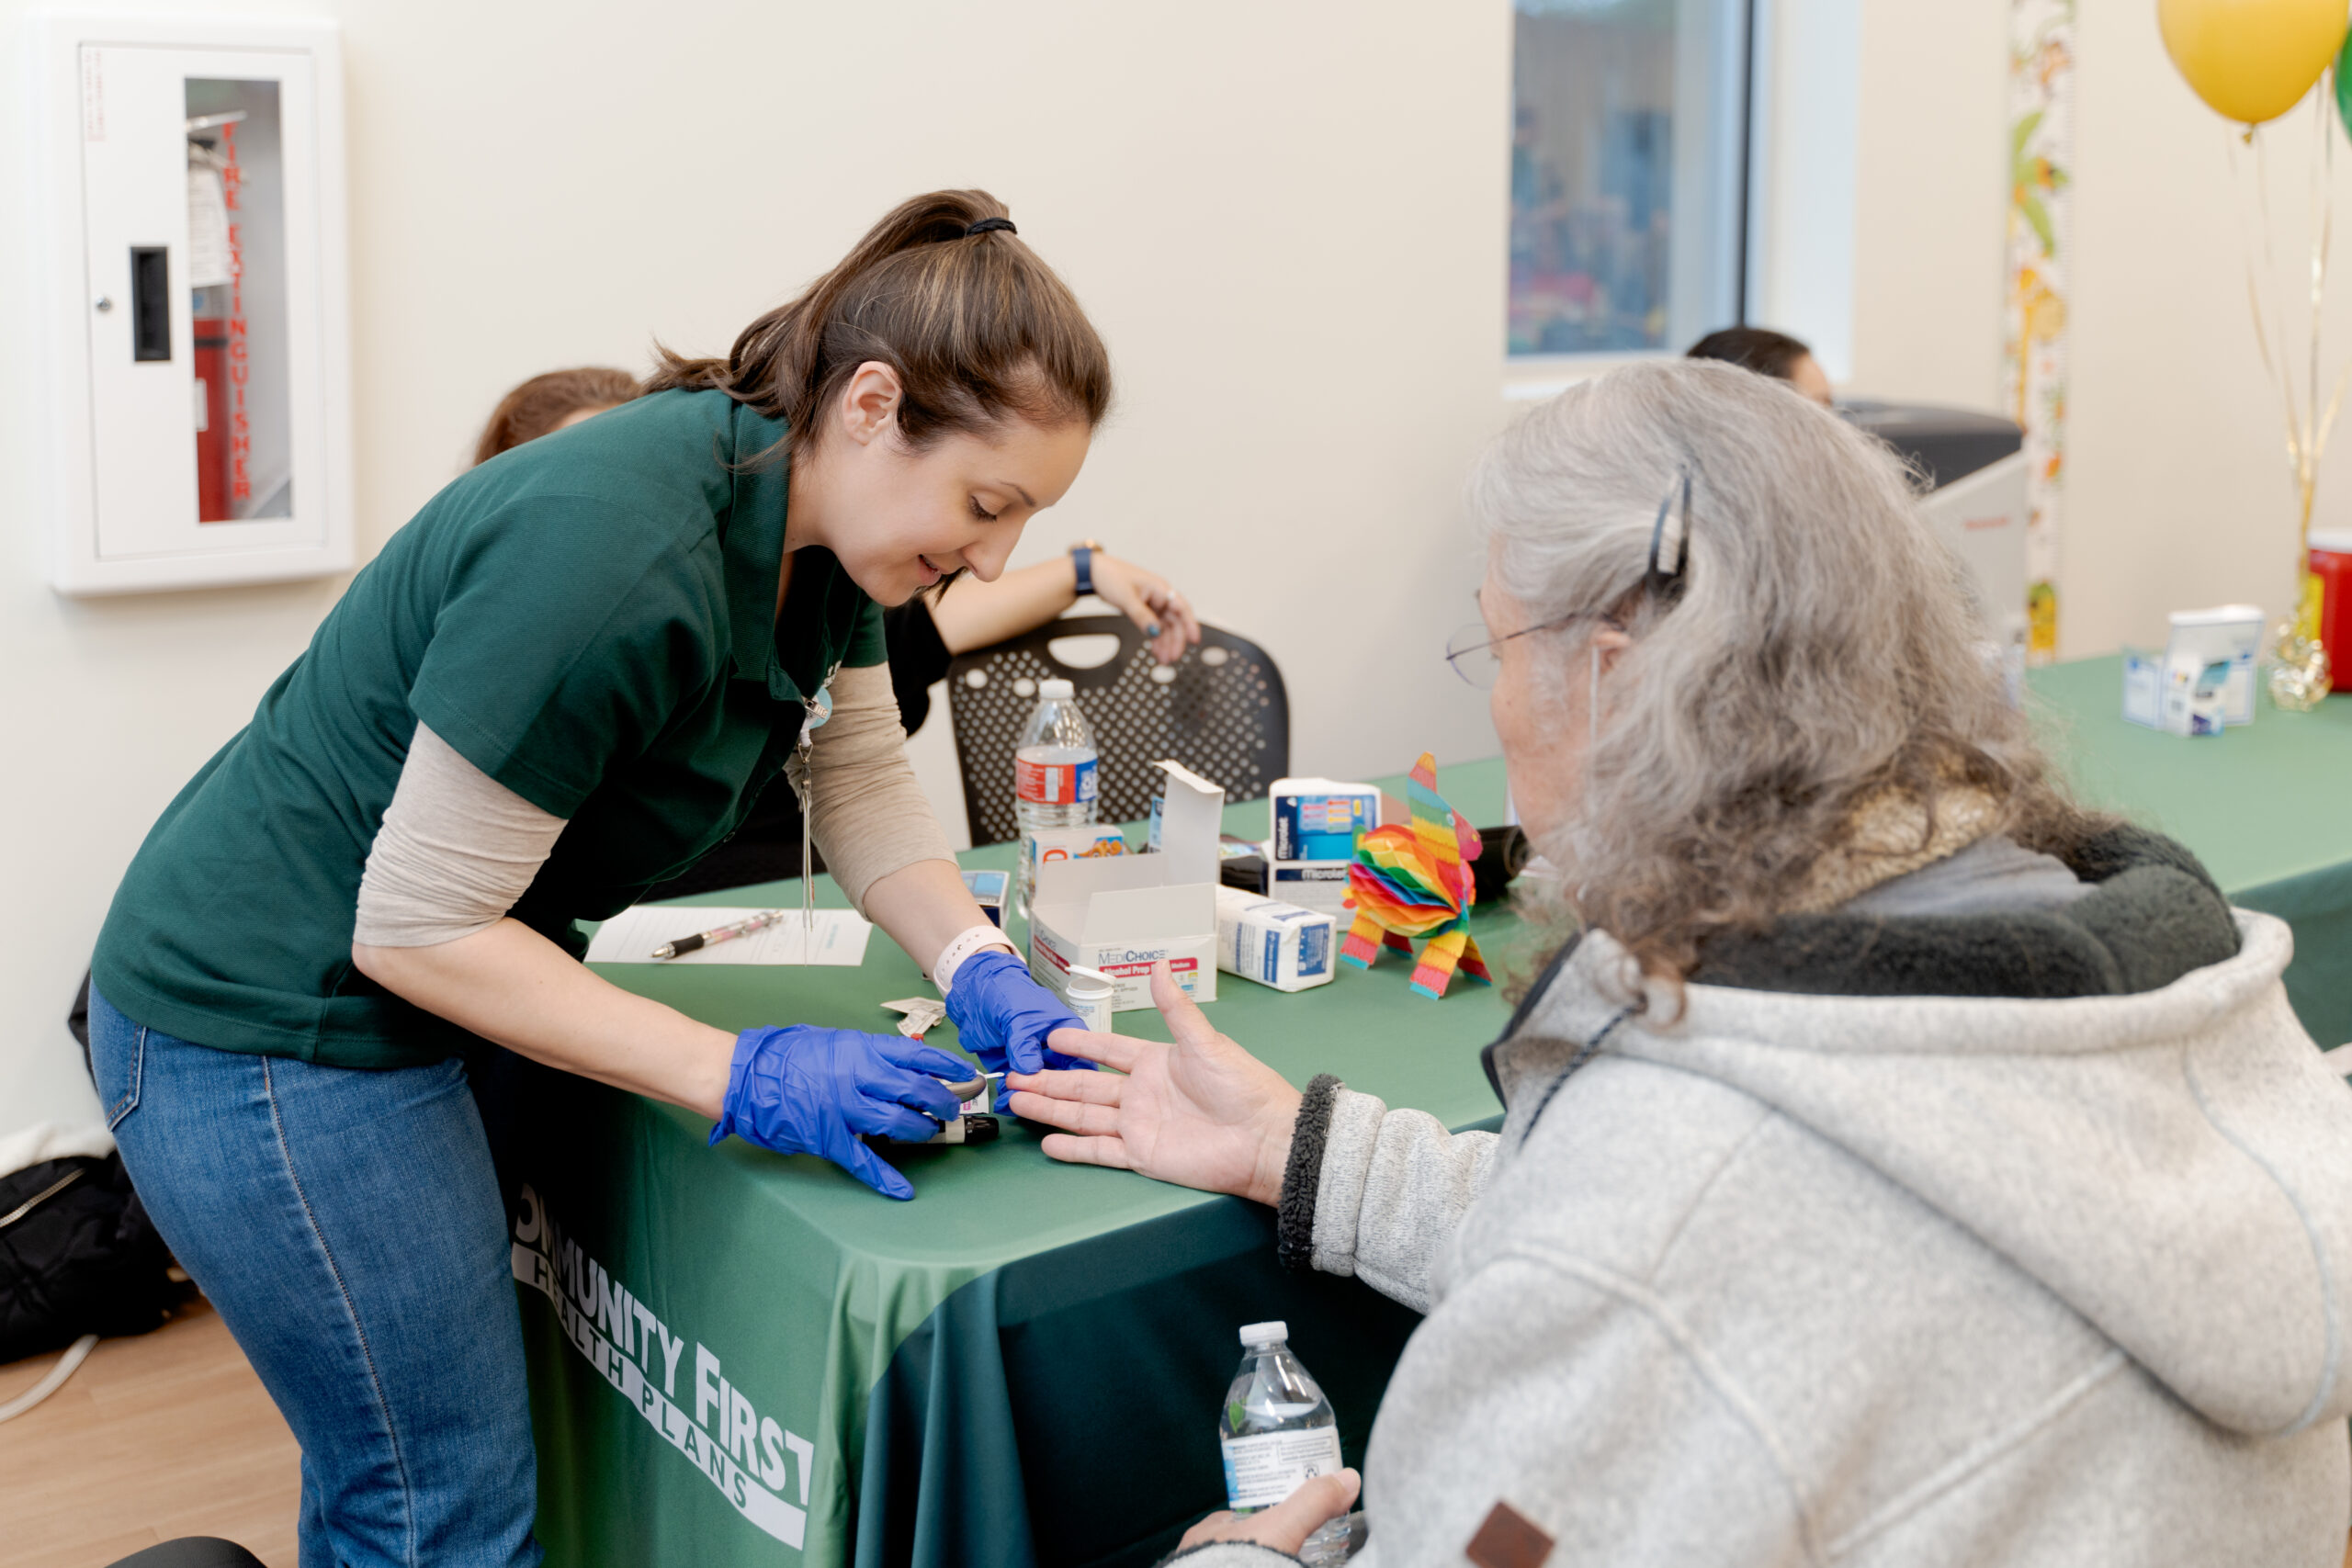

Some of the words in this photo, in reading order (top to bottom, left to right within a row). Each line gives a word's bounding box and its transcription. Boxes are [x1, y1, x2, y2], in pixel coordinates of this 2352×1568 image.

[221, 121, 242, 211] FIRE
[228, 223, 252, 502] EXTINGUISHER
[1132, 965, 1150, 976] Prep
[515, 1182, 684, 1399] OMMUNITY
[695, 1341, 815, 1507] FIRST
[534, 1254, 624, 1389] HEALTH
[642, 1381, 747, 1508] PLANS
